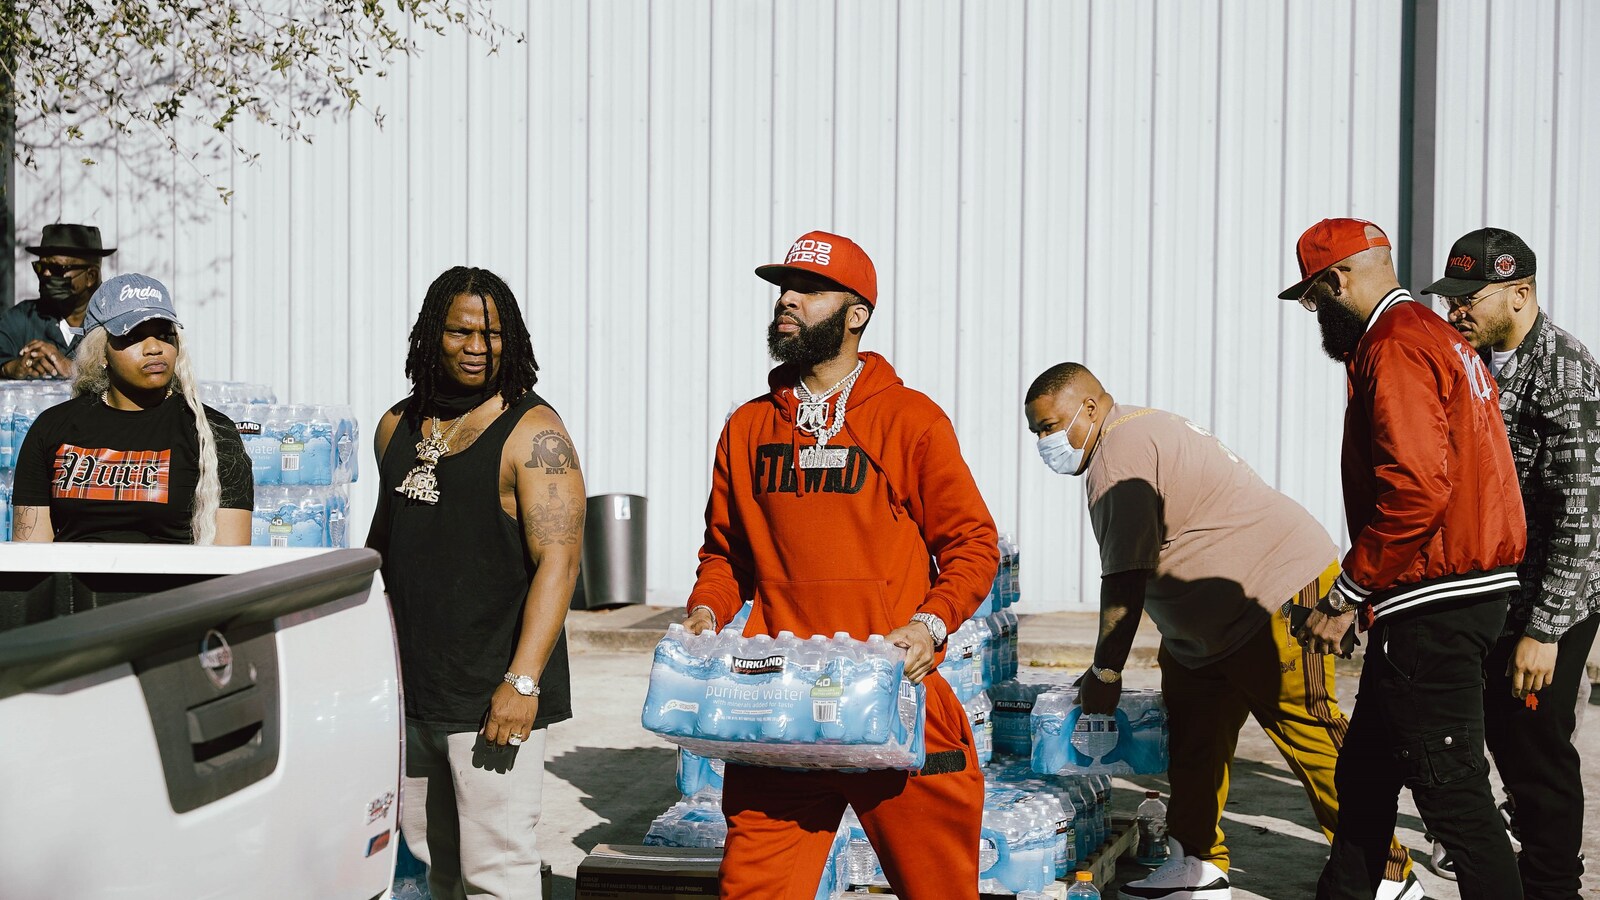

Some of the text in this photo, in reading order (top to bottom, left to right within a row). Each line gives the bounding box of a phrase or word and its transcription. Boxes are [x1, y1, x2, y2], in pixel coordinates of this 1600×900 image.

[790, 239, 832, 254] MOB
[786, 251, 831, 266] TIES
[119, 284, 162, 302] Errday
[59, 452, 158, 491] Pure
[545, 467, 567, 475] ENT.
[406, 487, 440, 502] THIS
[734, 656, 785, 669] KIRKLAND
[816, 678, 831, 687] 40
[705, 685, 760, 701] purified
[763, 687, 804, 702] water
[996, 701, 1032, 709] KIRKLAND
